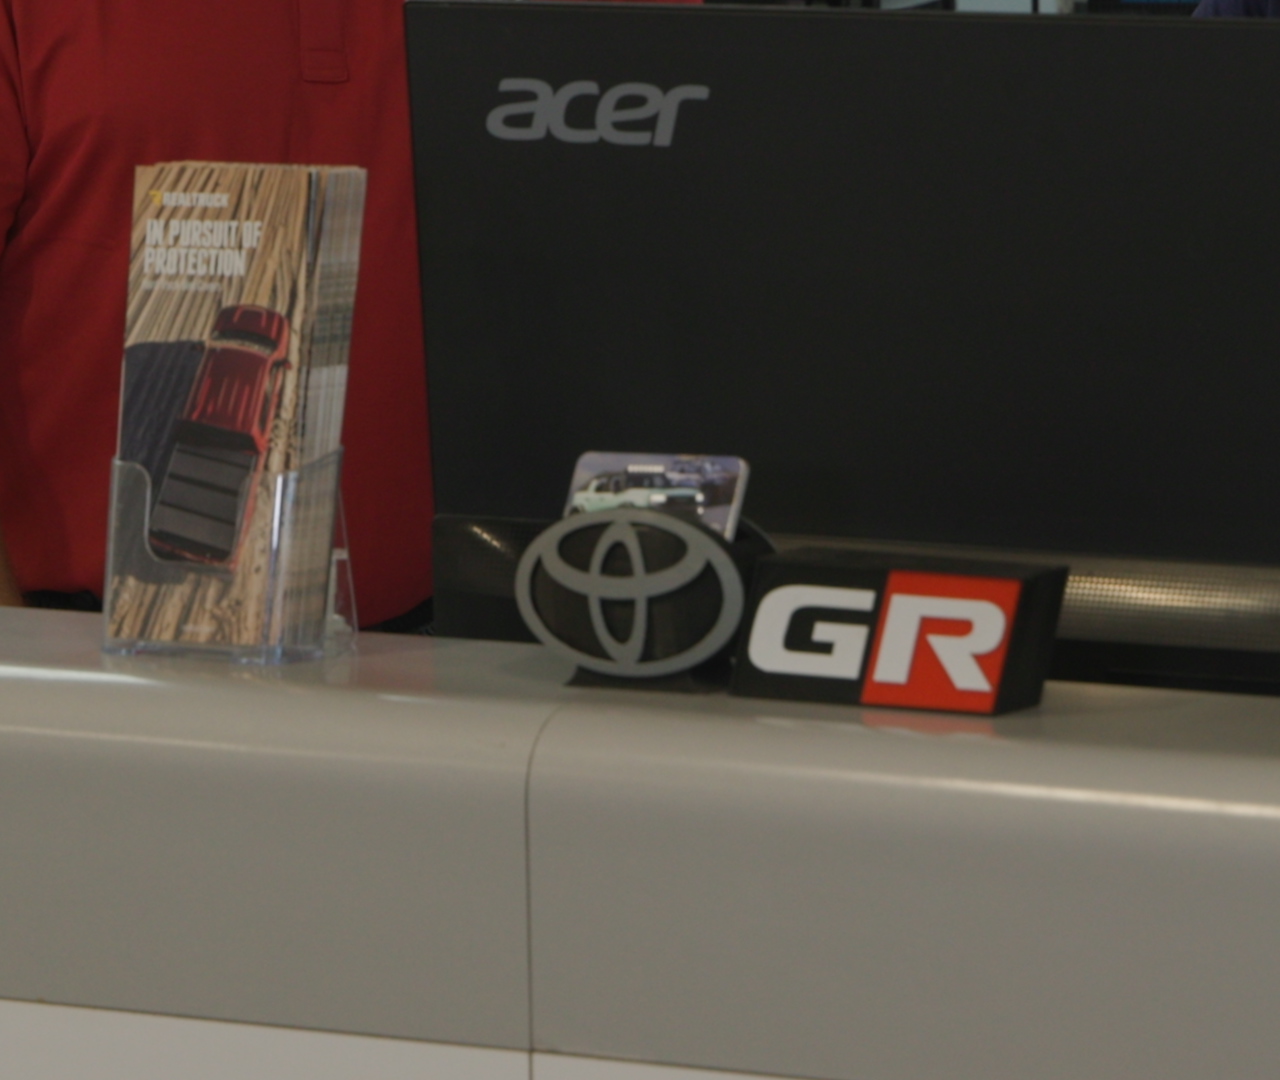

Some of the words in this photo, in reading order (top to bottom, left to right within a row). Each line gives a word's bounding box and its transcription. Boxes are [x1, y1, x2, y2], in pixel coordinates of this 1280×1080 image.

[485, 77, 711, 148] acer
[145, 218, 165, 247] IN
[168, 219, 239, 248] PURSUIT
[241, 220, 263, 249] OF
[143, 247, 247, 277] PROTECTION
[747, 584, 1009, 693] GR
